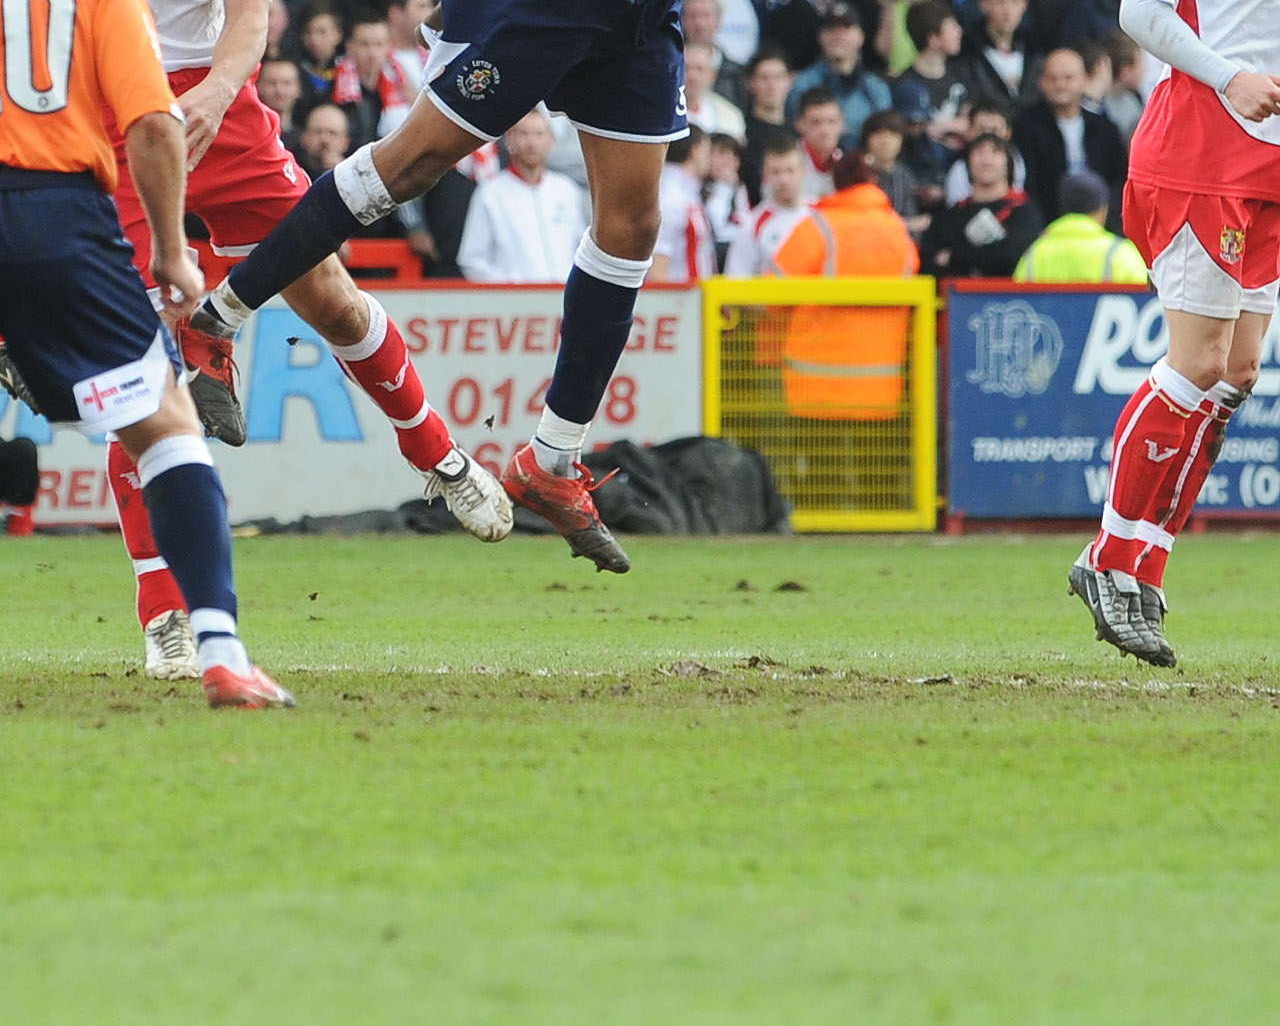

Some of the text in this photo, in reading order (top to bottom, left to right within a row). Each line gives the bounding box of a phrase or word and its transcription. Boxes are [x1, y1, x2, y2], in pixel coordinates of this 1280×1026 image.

[404, 316, 680, 354] STEVEGE
[447, 376, 638, 426] 0148
[972, 437, 1098, 463] TRANSPORT
